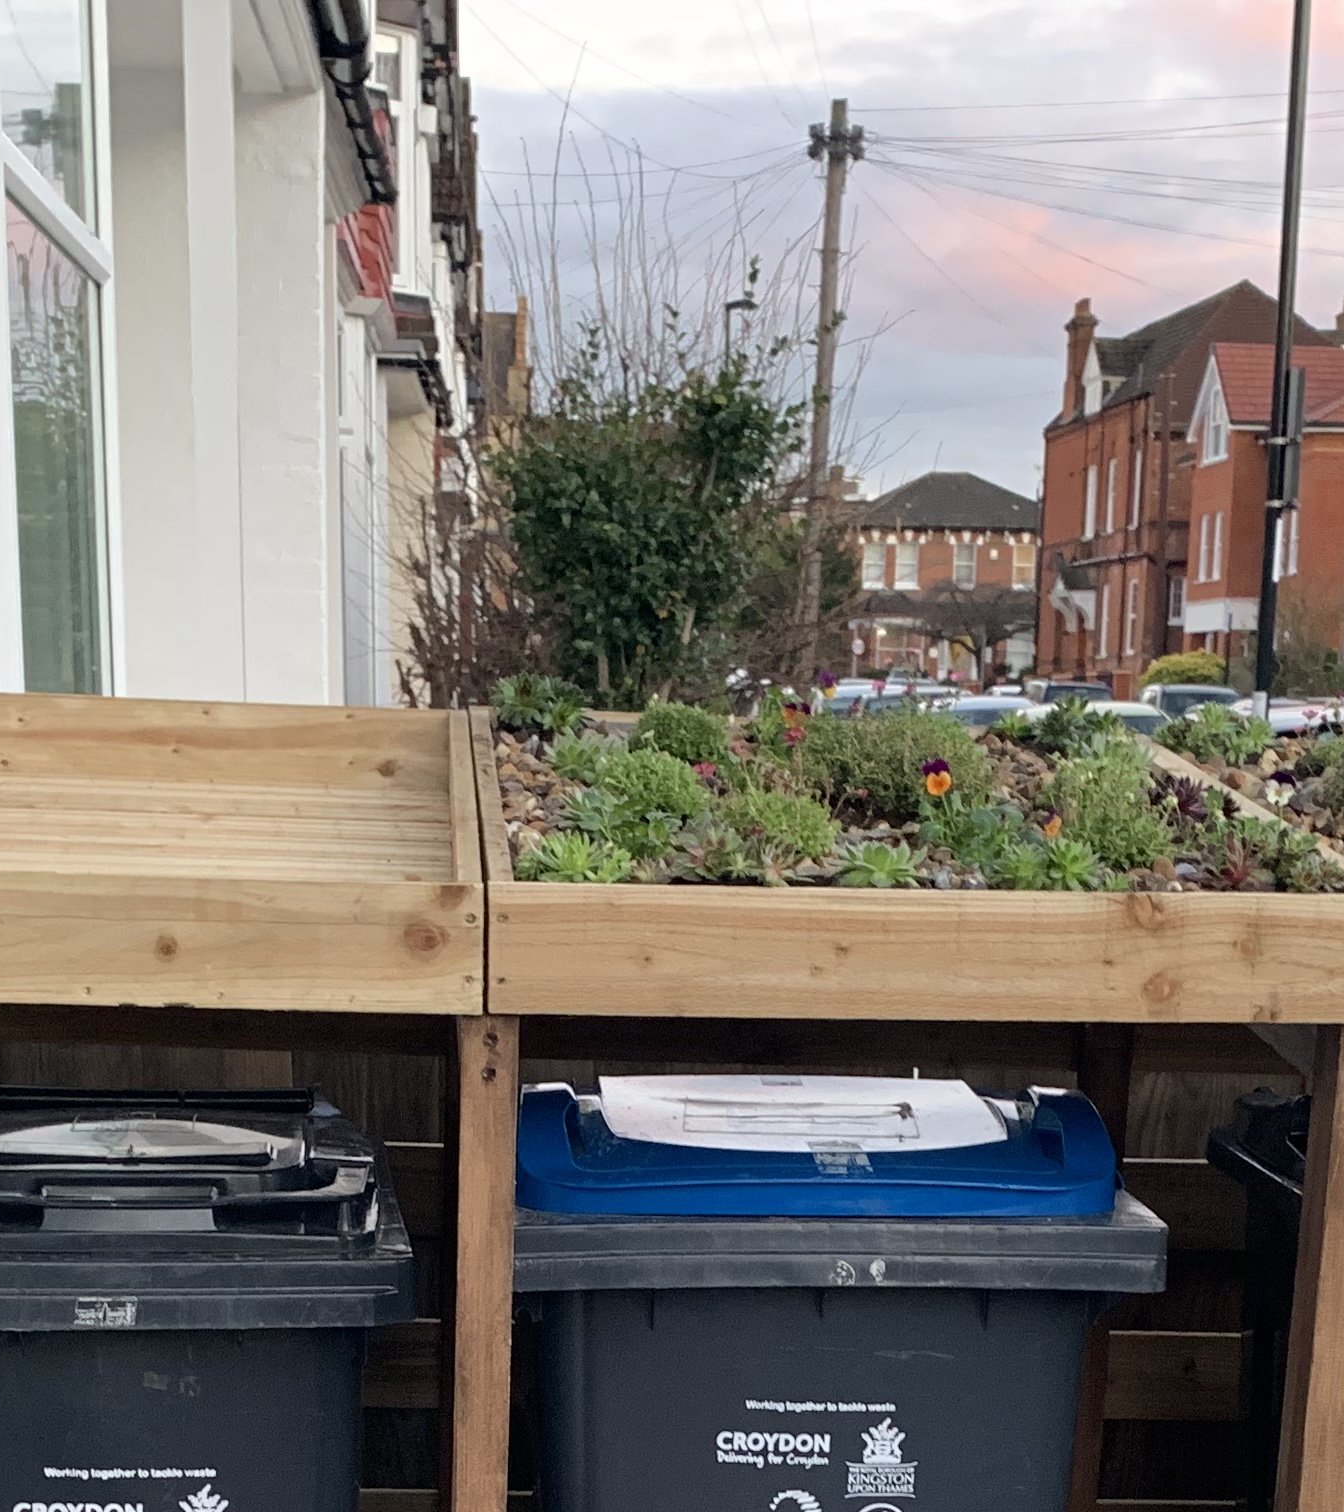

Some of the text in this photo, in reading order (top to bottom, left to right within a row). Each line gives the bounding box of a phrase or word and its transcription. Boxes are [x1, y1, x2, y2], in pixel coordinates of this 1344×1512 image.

[745, 1399, 785, 1412] Working
[827, 1401, 838, 1412] to
[716, 1431, 831, 1453] CROYDON
[717, 1450, 830, 1470] Delivering for Croydon
[44, 1467, 217, 1480] Working together to tackle waste
[847, 1473, 915, 1485] KINGSTON
[847, 1484, 914, 1493] UPON THAMES
